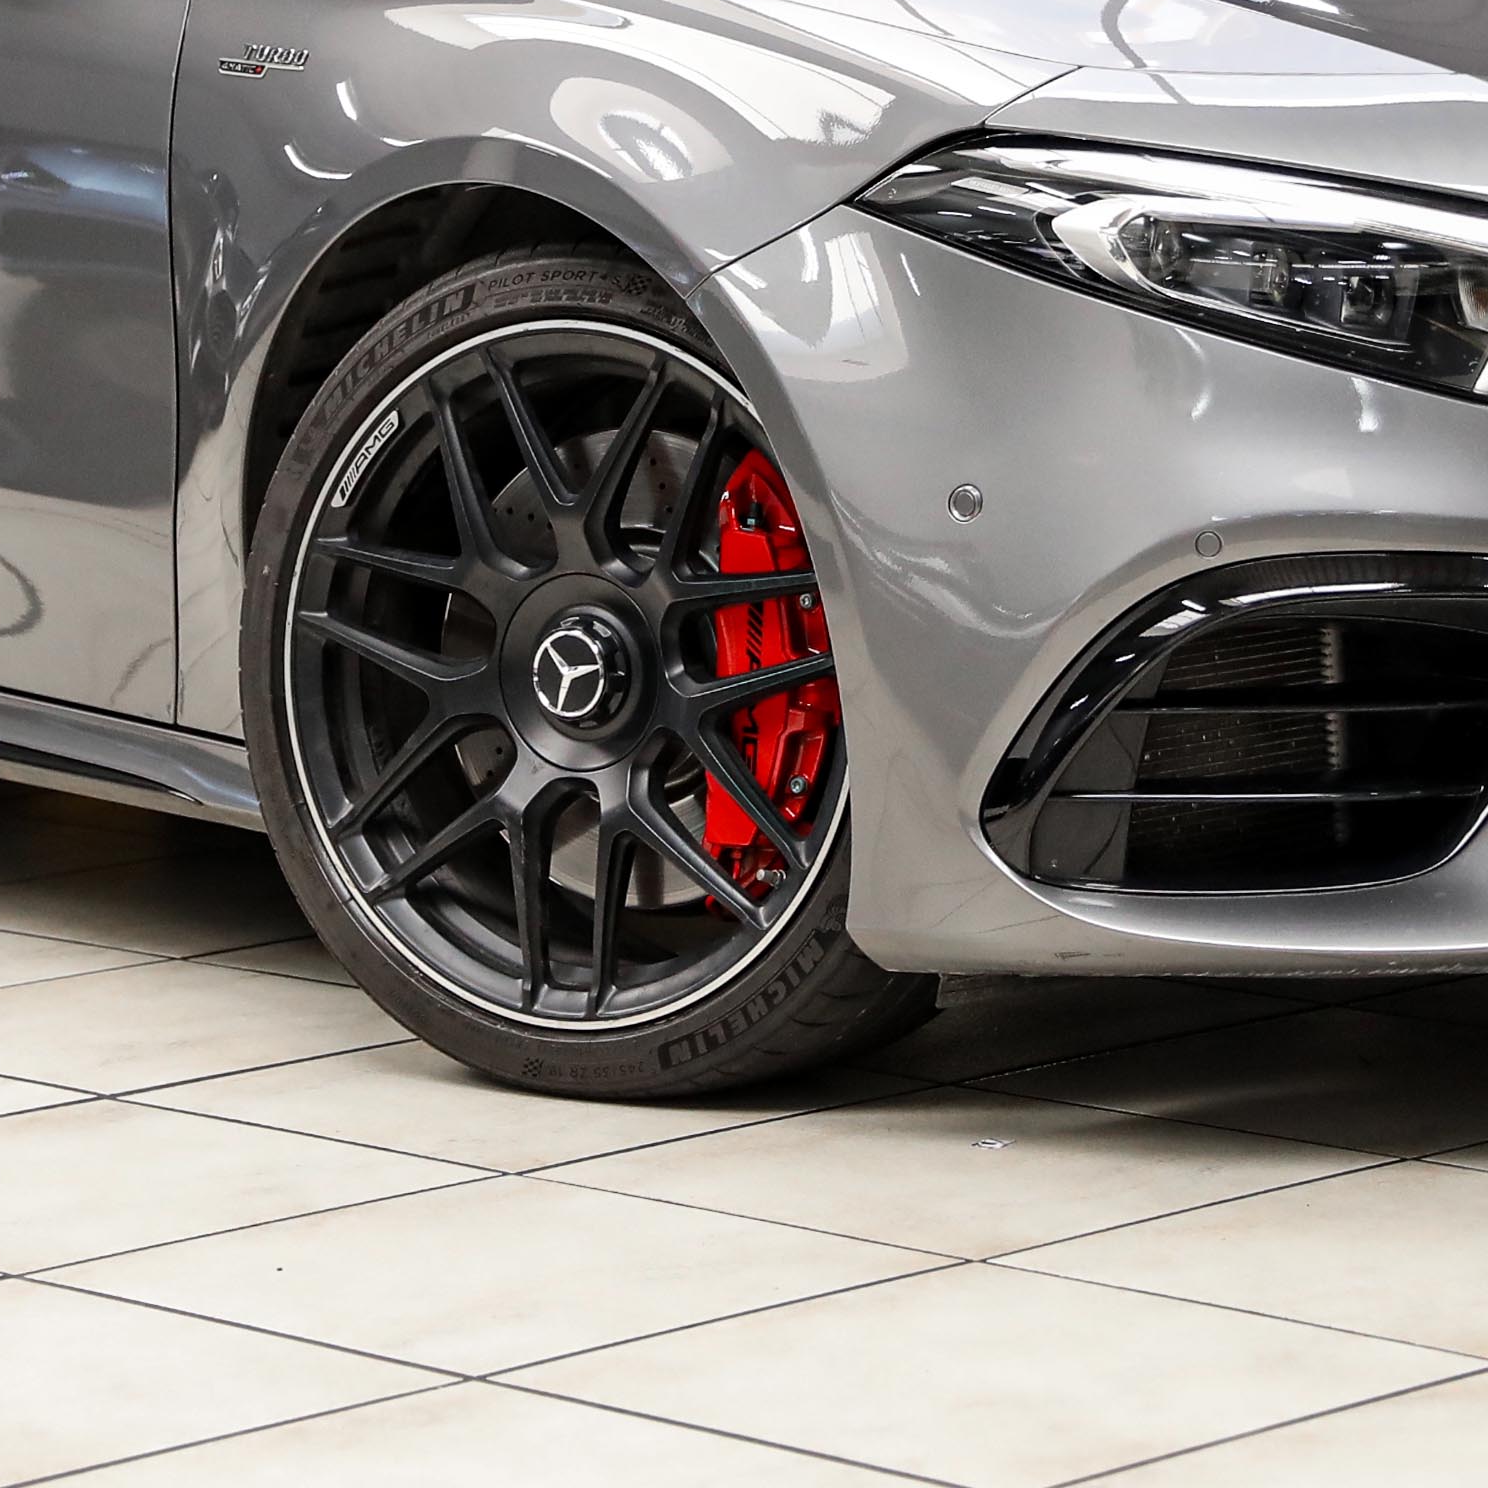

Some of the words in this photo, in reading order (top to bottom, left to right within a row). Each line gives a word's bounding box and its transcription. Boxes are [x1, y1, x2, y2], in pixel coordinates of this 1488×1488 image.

[243, 43, 309, 65] TURBO
[487, 272, 535, 291] PILOT
[540, 270, 599, 283] SPORT
[323, 289, 466, 421] MICHELIN
[667, 938, 826, 1066] MICHELIN
